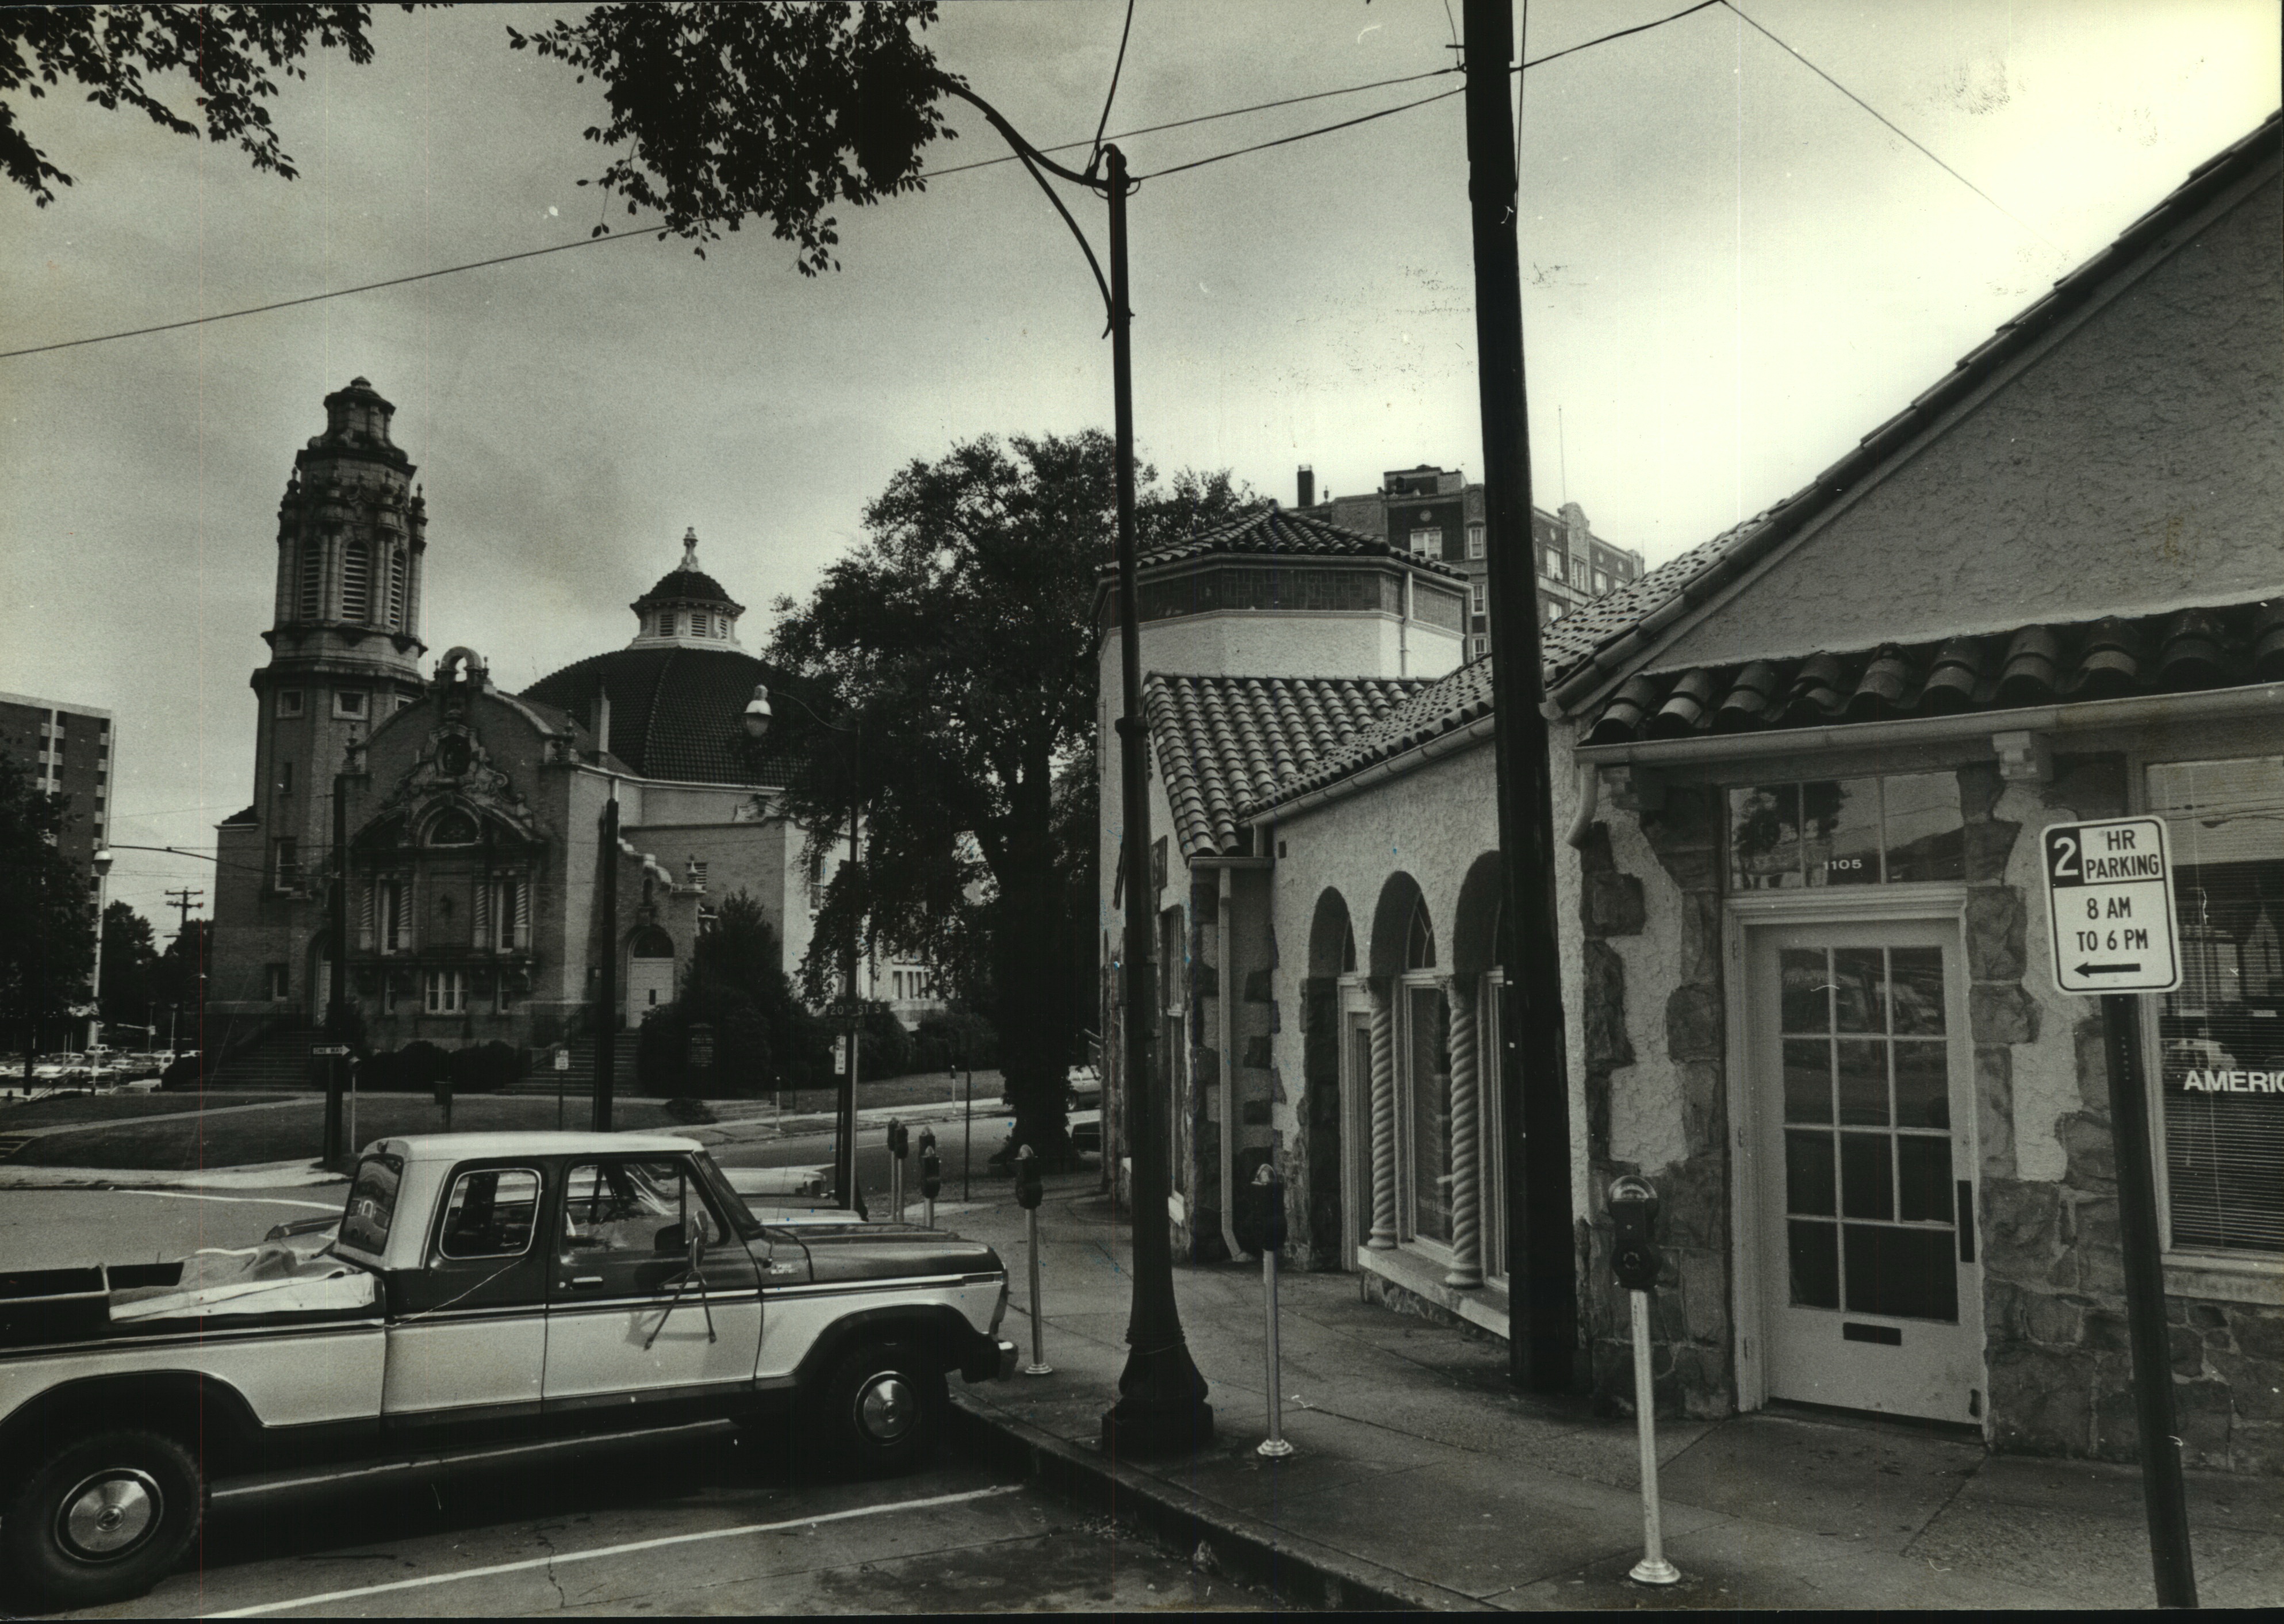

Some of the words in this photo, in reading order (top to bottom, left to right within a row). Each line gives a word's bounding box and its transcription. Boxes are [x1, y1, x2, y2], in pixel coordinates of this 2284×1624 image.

[2053, 837, 2079, 877] 2
[2107, 829, 2136, 851] HR
[1823, 859, 1862, 871] 1105
[2086, 853, 2160, 879] PARKING
[2087, 897, 2099, 920] 8
[2107, 897, 2132, 918] AM
[2076, 930, 2099, 952] TO
[2107, 930, 2118, 950] 6
[2125, 929, 2149, 950] PM
[857, 1004, 869, 1014] ST
[875, 1003, 881, 1013] S
